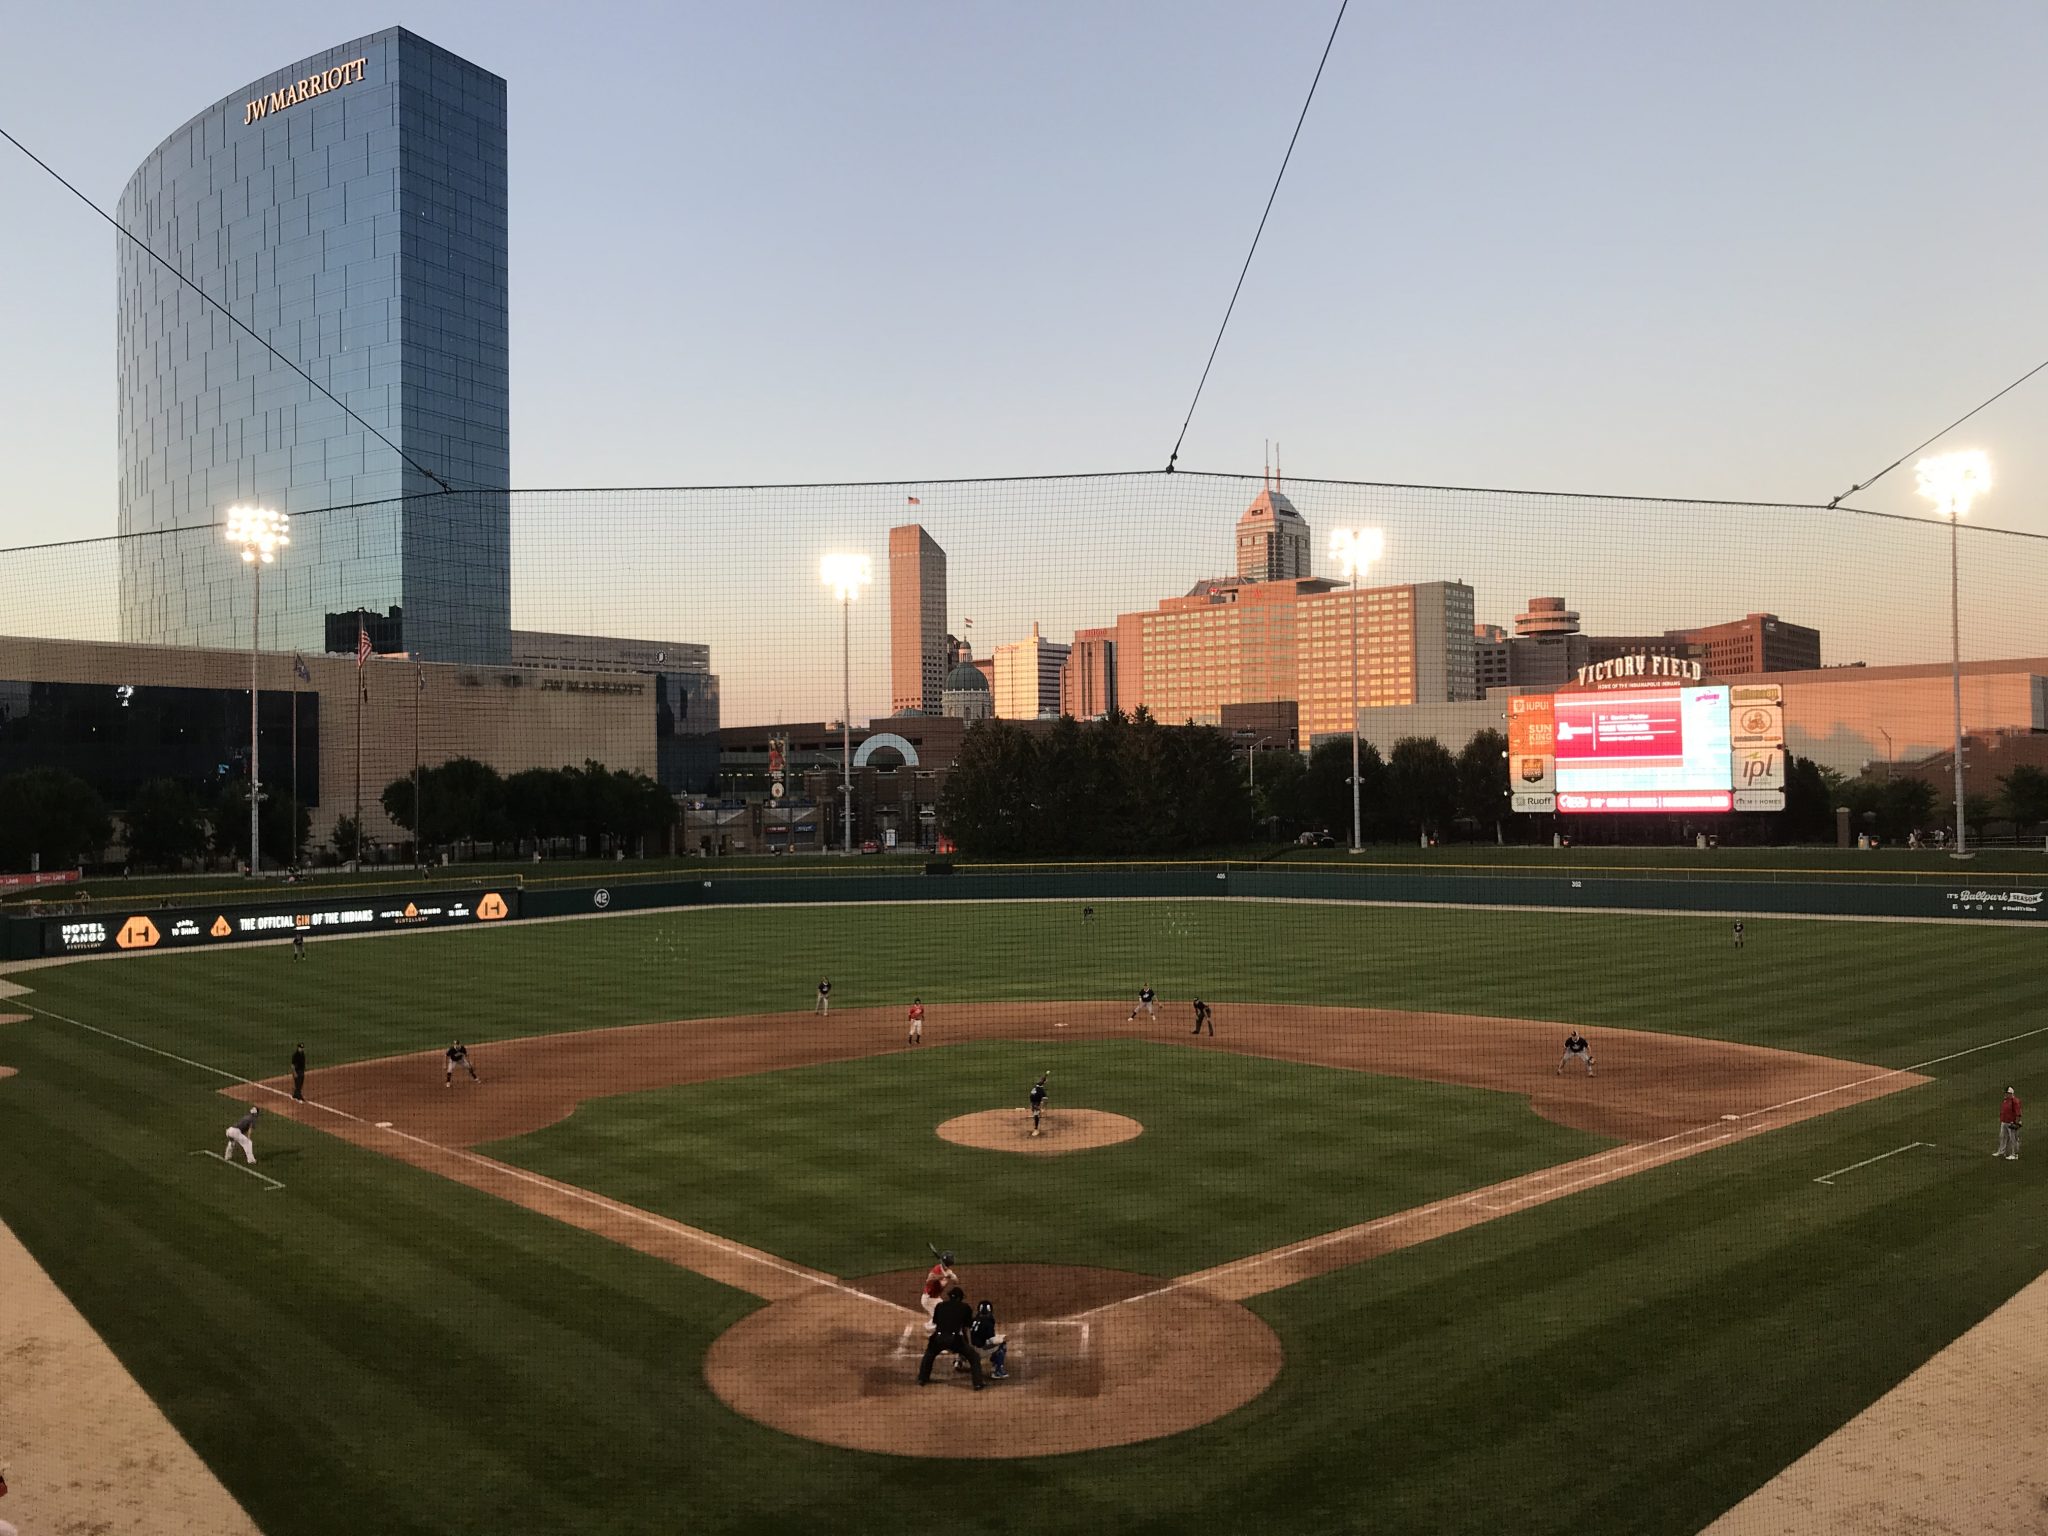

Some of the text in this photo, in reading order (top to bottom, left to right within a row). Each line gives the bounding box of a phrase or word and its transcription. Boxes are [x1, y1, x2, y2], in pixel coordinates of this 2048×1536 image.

[244, 58, 368, 125] JW MARRIOTT
[1577, 655, 1701, 686] VICTORY FIELD
[1526, 702, 1548, 710] IUPUI
[1529, 724, 1552, 733] SUN
[1529, 733, 1552, 741] KING
[596, 892, 607, 903] 42
[1960, 890, 2008, 903] Ballpark
[240, 910, 373, 930] THE OFFICIAL GIN OF THE INDIANS
[62, 924, 105, 934] HOTEL
[180, 926, 200, 935] SHARE
[62, 933, 106, 944] TANGO
